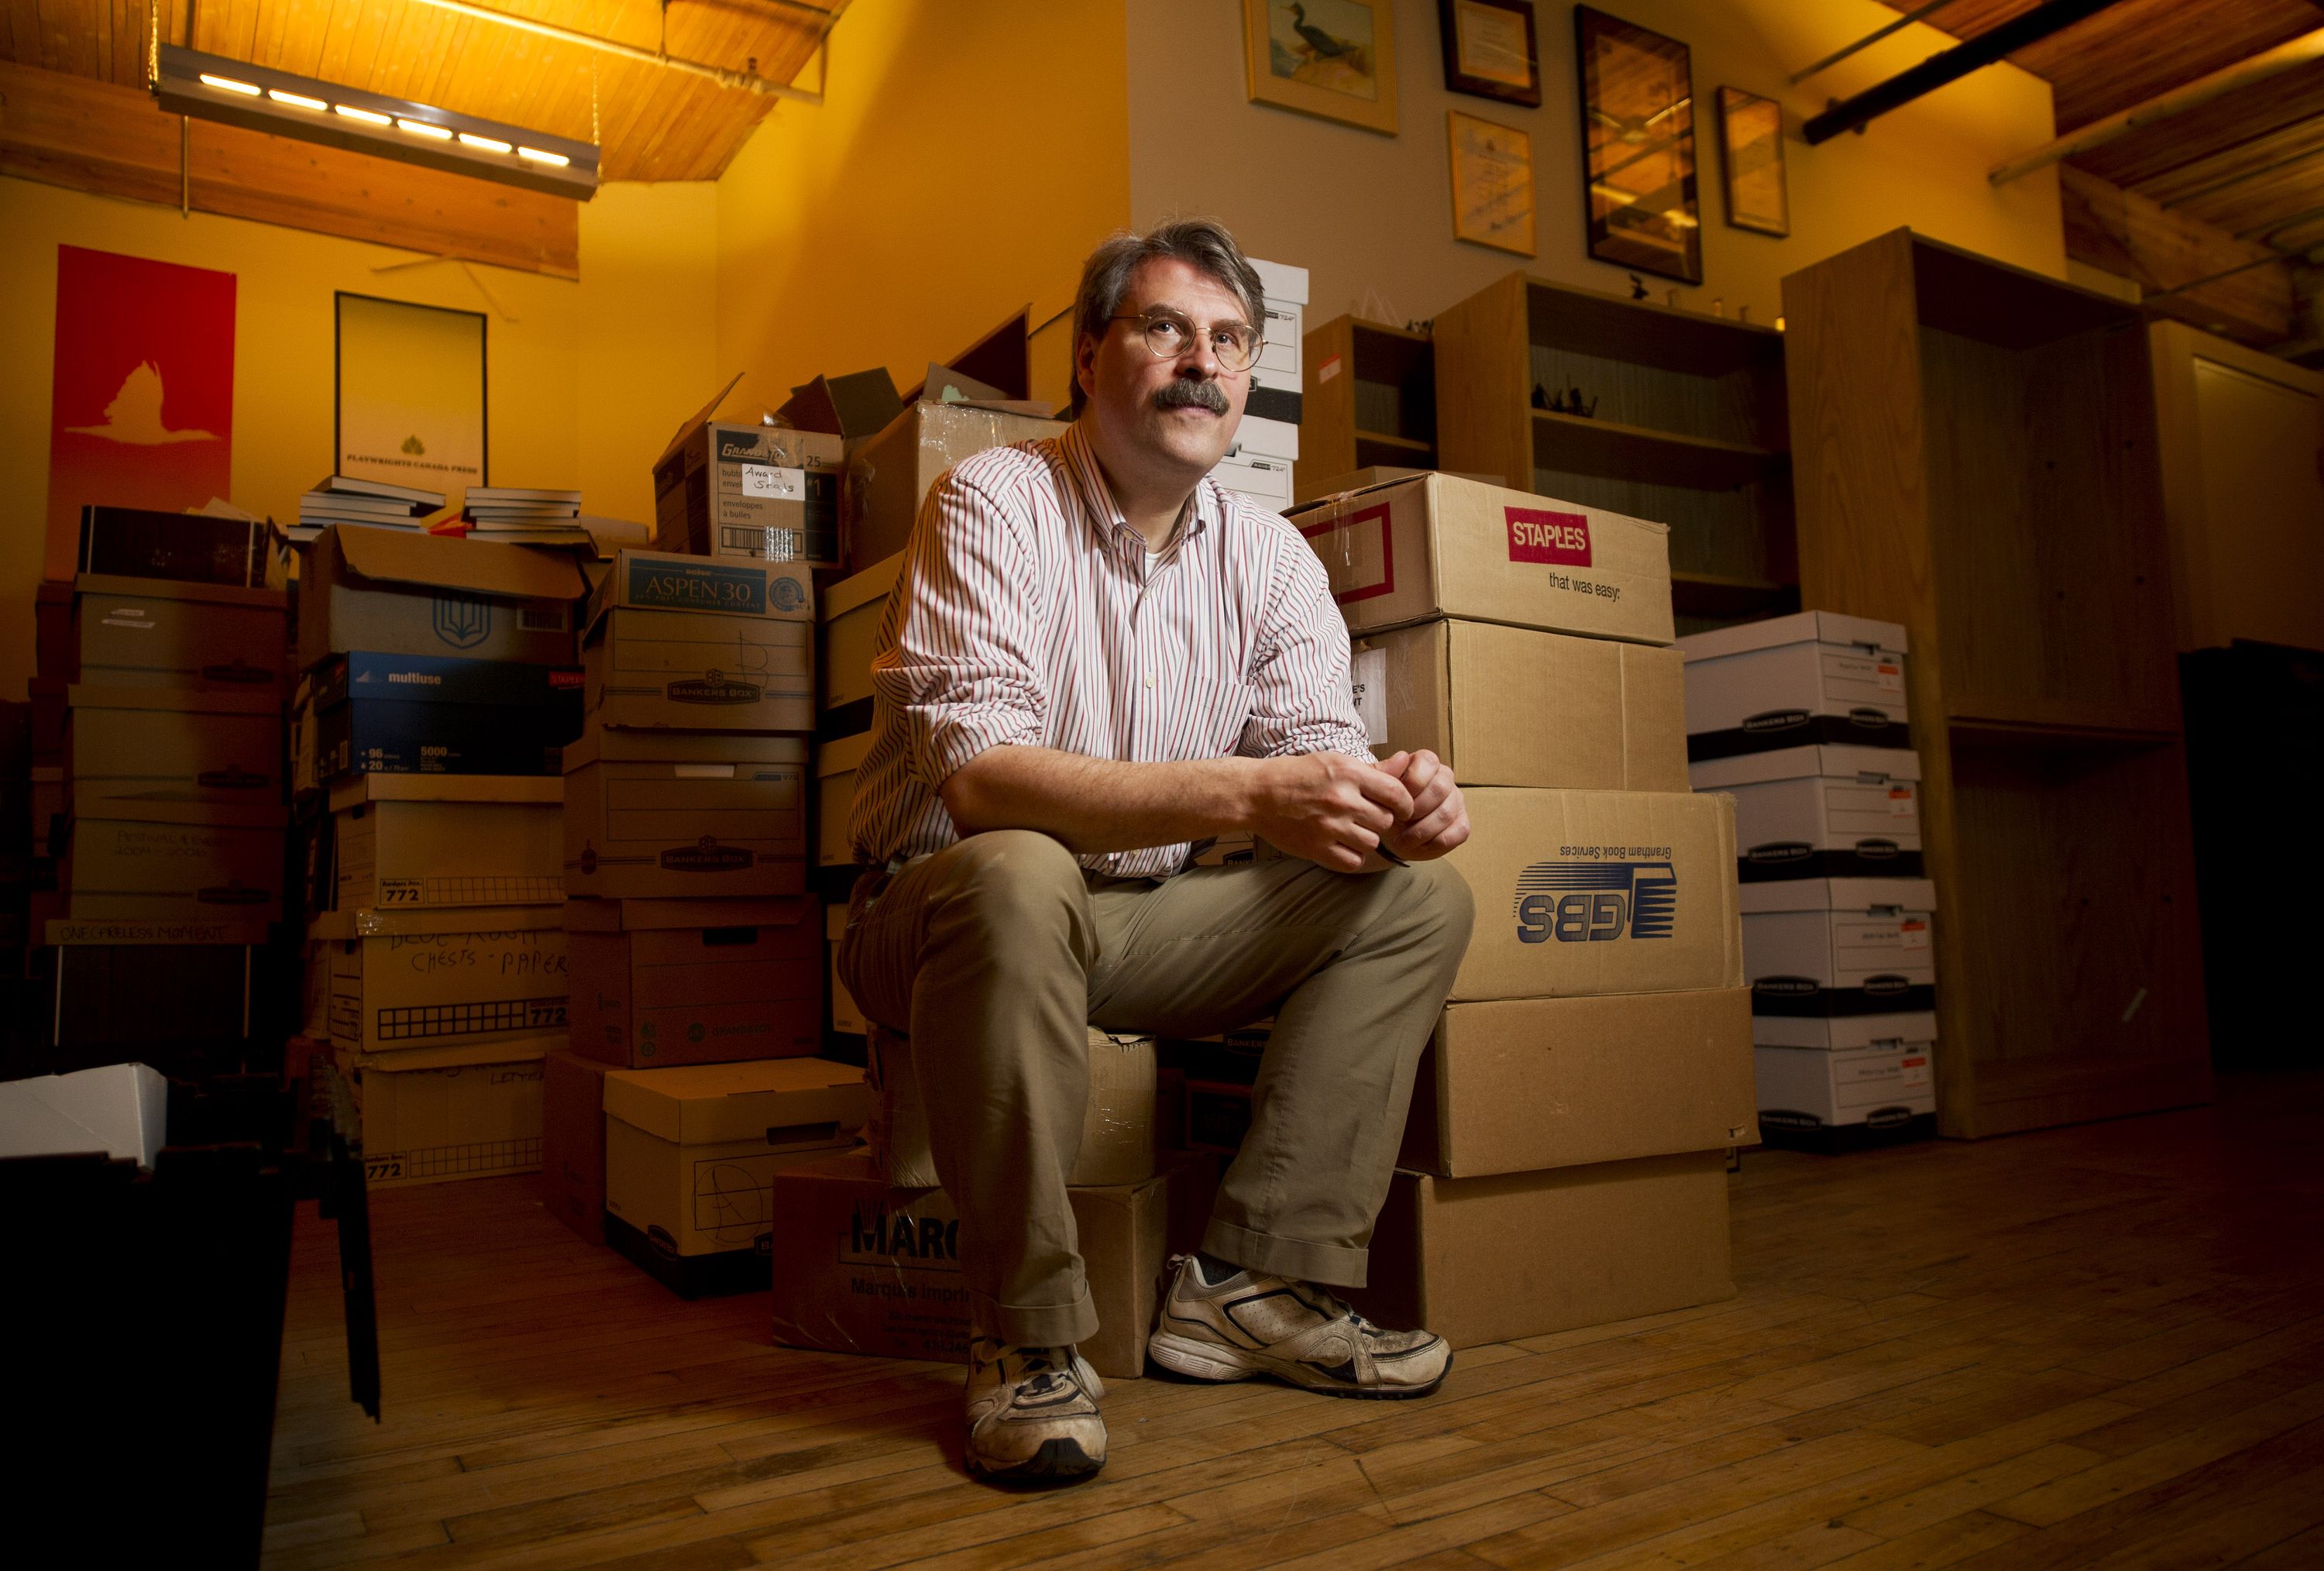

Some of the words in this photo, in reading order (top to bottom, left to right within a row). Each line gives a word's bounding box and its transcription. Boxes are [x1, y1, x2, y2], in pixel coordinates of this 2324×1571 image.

[347, 454, 411, 468] PLAYWRIGHTS
[414, 462, 449, 472] CANADA
[451, 466, 477, 474] PRESS
[806, 455, 821, 467] 25
[745, 467, 782, 479] Award
[723, 500, 763, 510] enveloppes
[730, 510, 751, 520] bulles
[1513, 521, 1587, 551] STAPLES
[646, 576, 720, 600] ASPEN
[722, 582, 751, 602] 30
[1549, 572, 1569, 590] that
[1573, 579, 1593, 595] was
[388, 672, 442, 686] multiuse
[672, 686, 726, 697] BANKERS
[728, 687, 752, 698] BOX
[421, 746, 448, 757] 5000
[368, 760, 383, 772] 20
[1560, 846, 1600, 859] Services
[1603, 846, 1626, 859] Book
[1628, 846, 1672, 859] Grantham
[386, 889, 419, 902] 772
[1517, 894, 1626, 944] GBS
[411, 948, 476, 974] CHESTS
[500, 950, 569, 976] PAPER
[531, 1007, 566, 1024] 772
[368, 1163, 401, 1179] 772
[851, 1277, 917, 1301] Marquis
